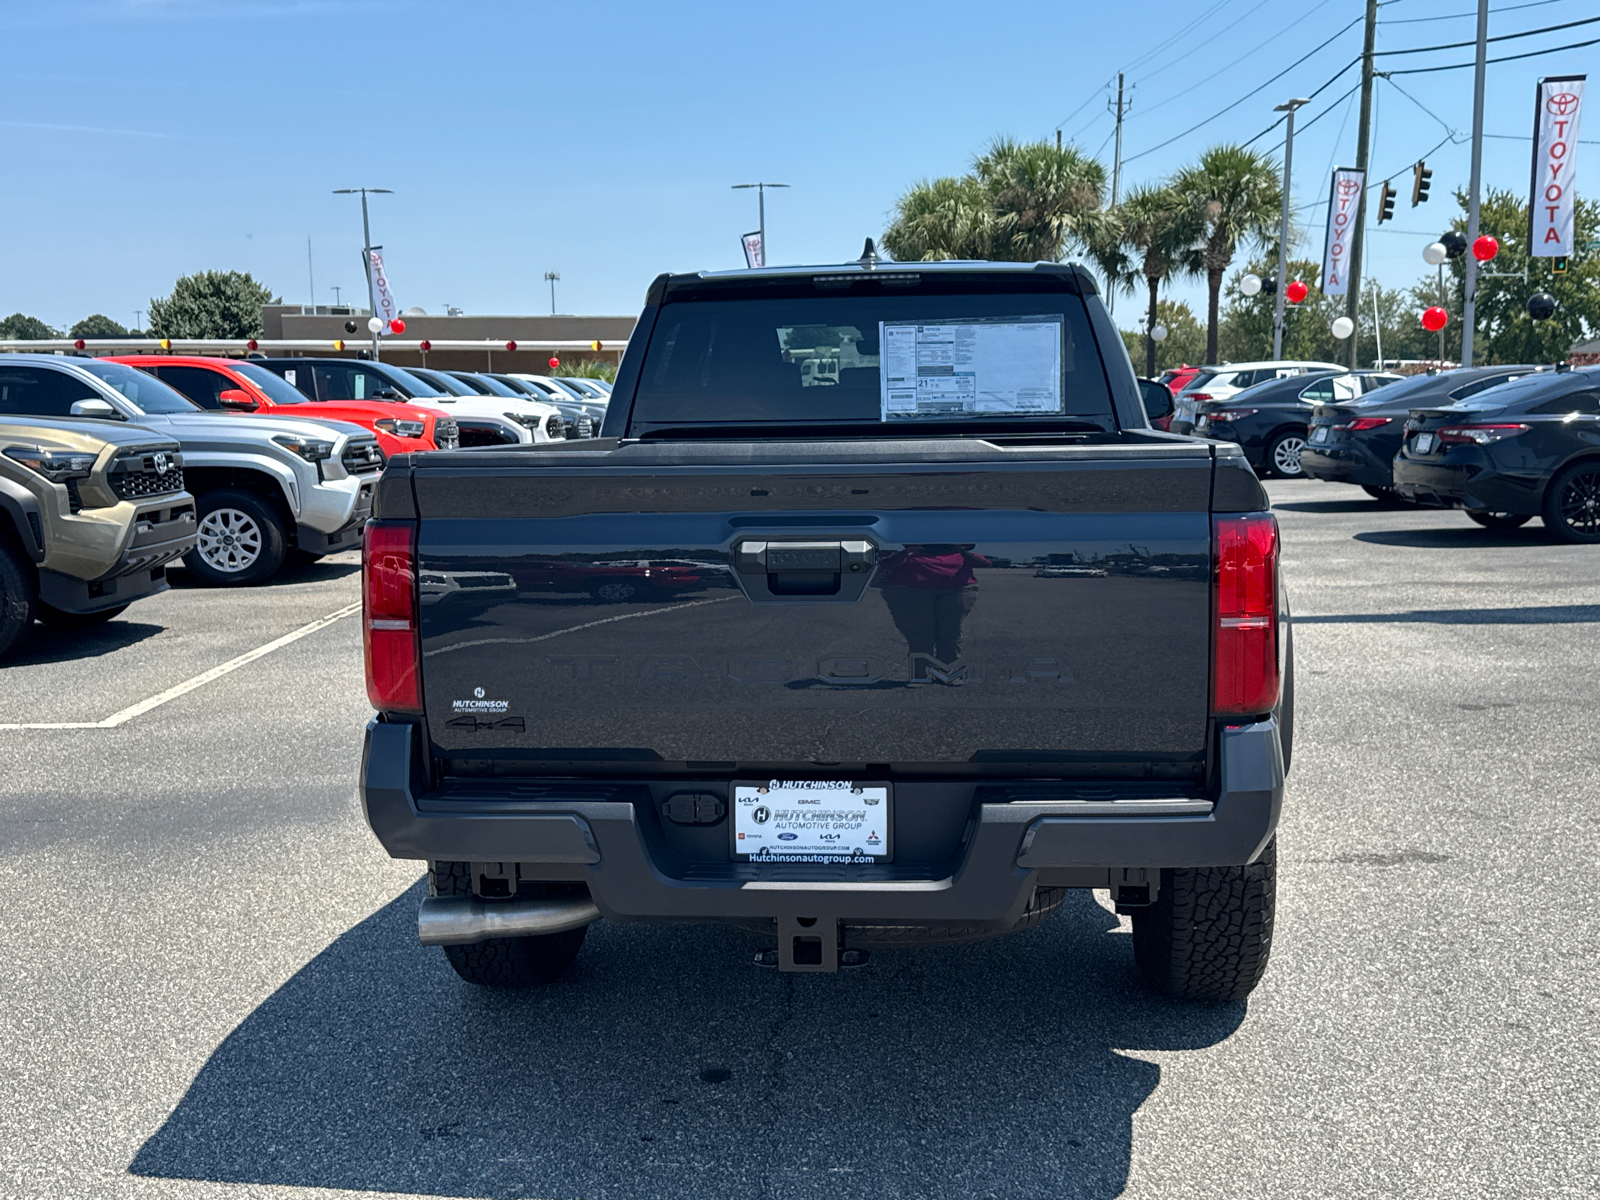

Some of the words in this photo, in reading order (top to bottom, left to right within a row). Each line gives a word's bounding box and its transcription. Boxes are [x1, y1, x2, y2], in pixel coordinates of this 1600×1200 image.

[1544, 120, 1569, 244] TOYOTA
[1328, 198, 1350, 286] TOYOTA
[918, 379, 928, 387] 21
[545, 652, 1080, 684] TACOMA
[452, 700, 509, 708] HUTCHINSON
[781, 780, 852, 791] HUTCHINSON
[774, 809, 866, 822] HUTCHINSON
[775, 822, 831, 830] AUTOMOTIVE
[832, 822, 862, 830] GROUP
[749, 853, 875, 865] Hutchinsonautogroup.com
